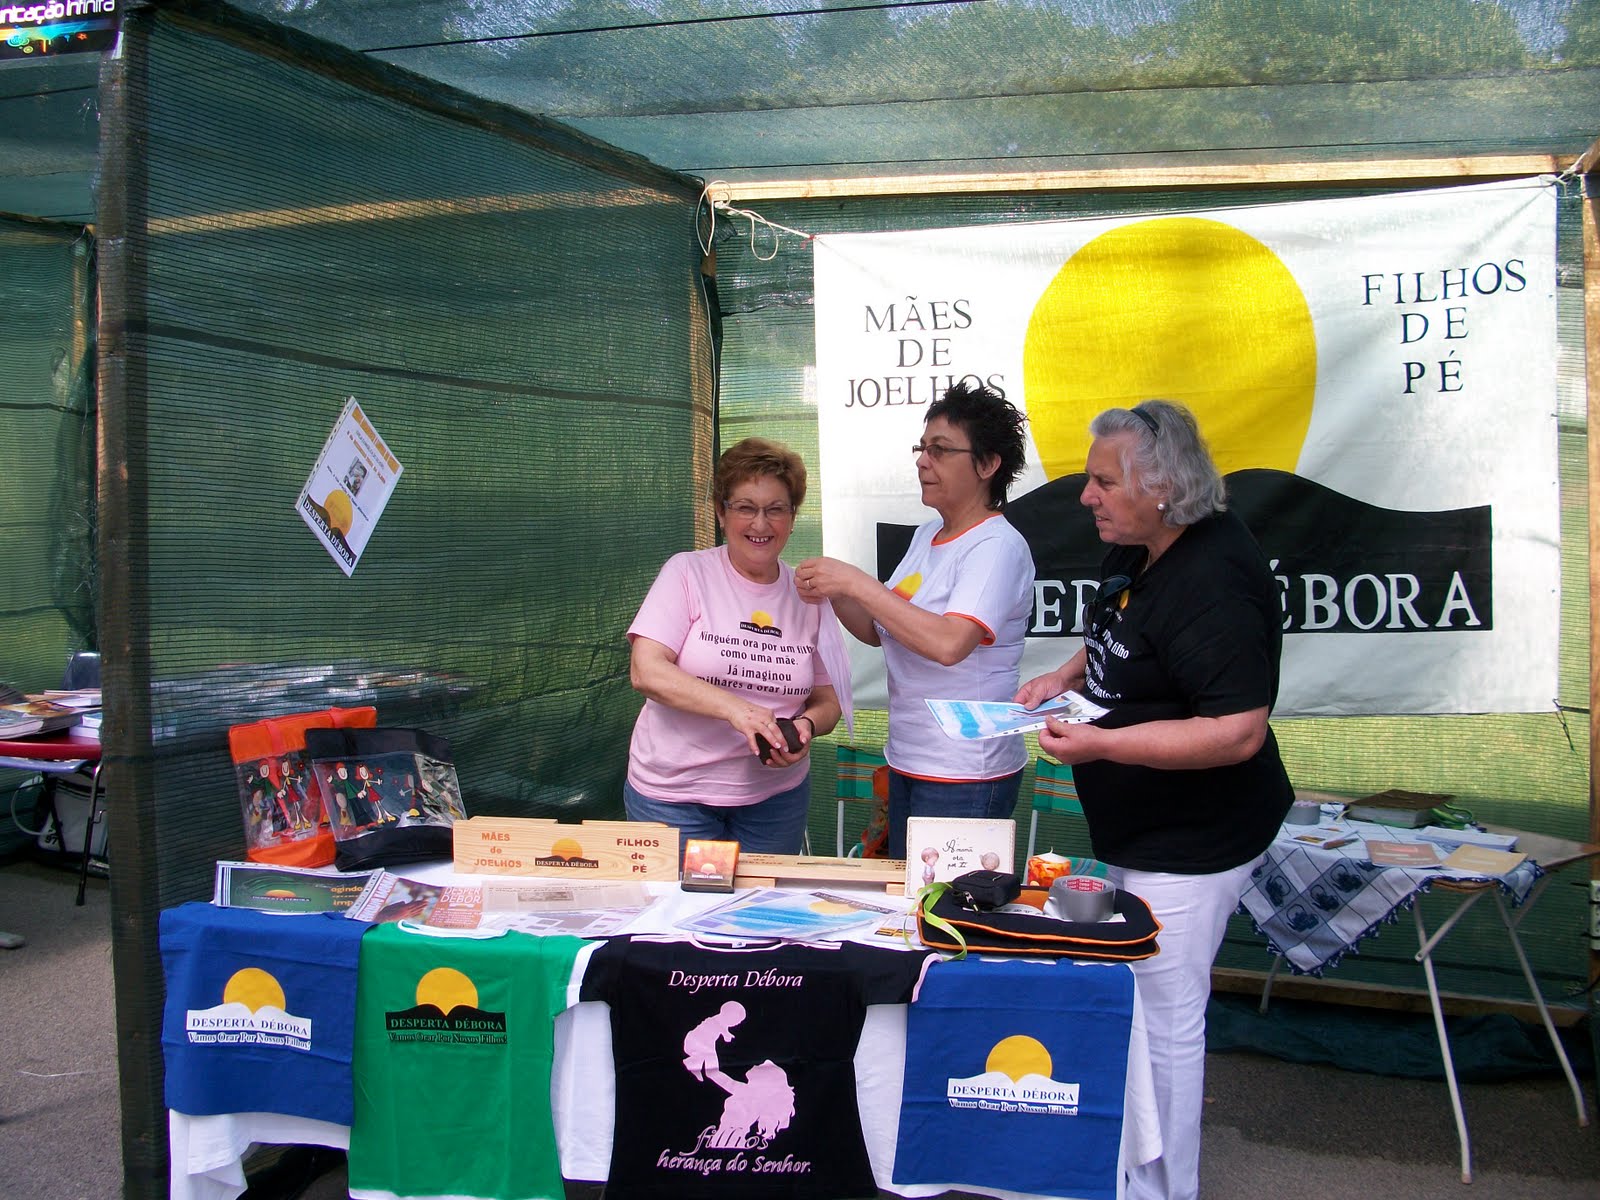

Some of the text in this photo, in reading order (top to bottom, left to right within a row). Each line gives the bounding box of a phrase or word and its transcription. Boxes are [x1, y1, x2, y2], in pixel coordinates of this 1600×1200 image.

[0, 0, 64, 24] ntação
[1361, 259, 1526, 306] FILHOS
[864, 296, 972, 332] MÃES
[1400, 307, 1469, 344] DE
[896, 338, 952, 367] DE
[1403, 350, 1464, 394] PÉ
[304, 499, 332, 539] DESPERTA
[331, 535, 353, 568] DÉBORA
[699, 630, 739, 645] Ninguém
[743, 638, 758, 648] ora
[762, 642, 777, 651] por
[780, 645, 795, 653] um
[1111, 641, 1129, 659] filho
[720, 649, 798, 665] como uma mãe.
[727, 664, 791, 681] Já imaginou
[757, 685, 780, 693] orar
[474, 859, 522, 868] JOELHOS
[631, 852, 645, 860] de
[632, 864, 647, 873] PÉ
[668, 968, 803, 993] Desperta Débora
[192, 1018, 308, 1036] DESPERTA DÉBORA
[391, 1018, 503, 1030] DESPERTA DÉBORA
[188, 1032, 311, 1050] Vamos Orar Por Nossos Filhos!
[953, 1086, 1074, 1102] DESPERTA DÉBORA
[949, 1099, 977, 1109] Vamos
[1001, 1102, 1017, 1112] Por
[1017, 1103, 1047, 1114] Nossos
[657, 1149, 811, 1175] herança do Senhor.
